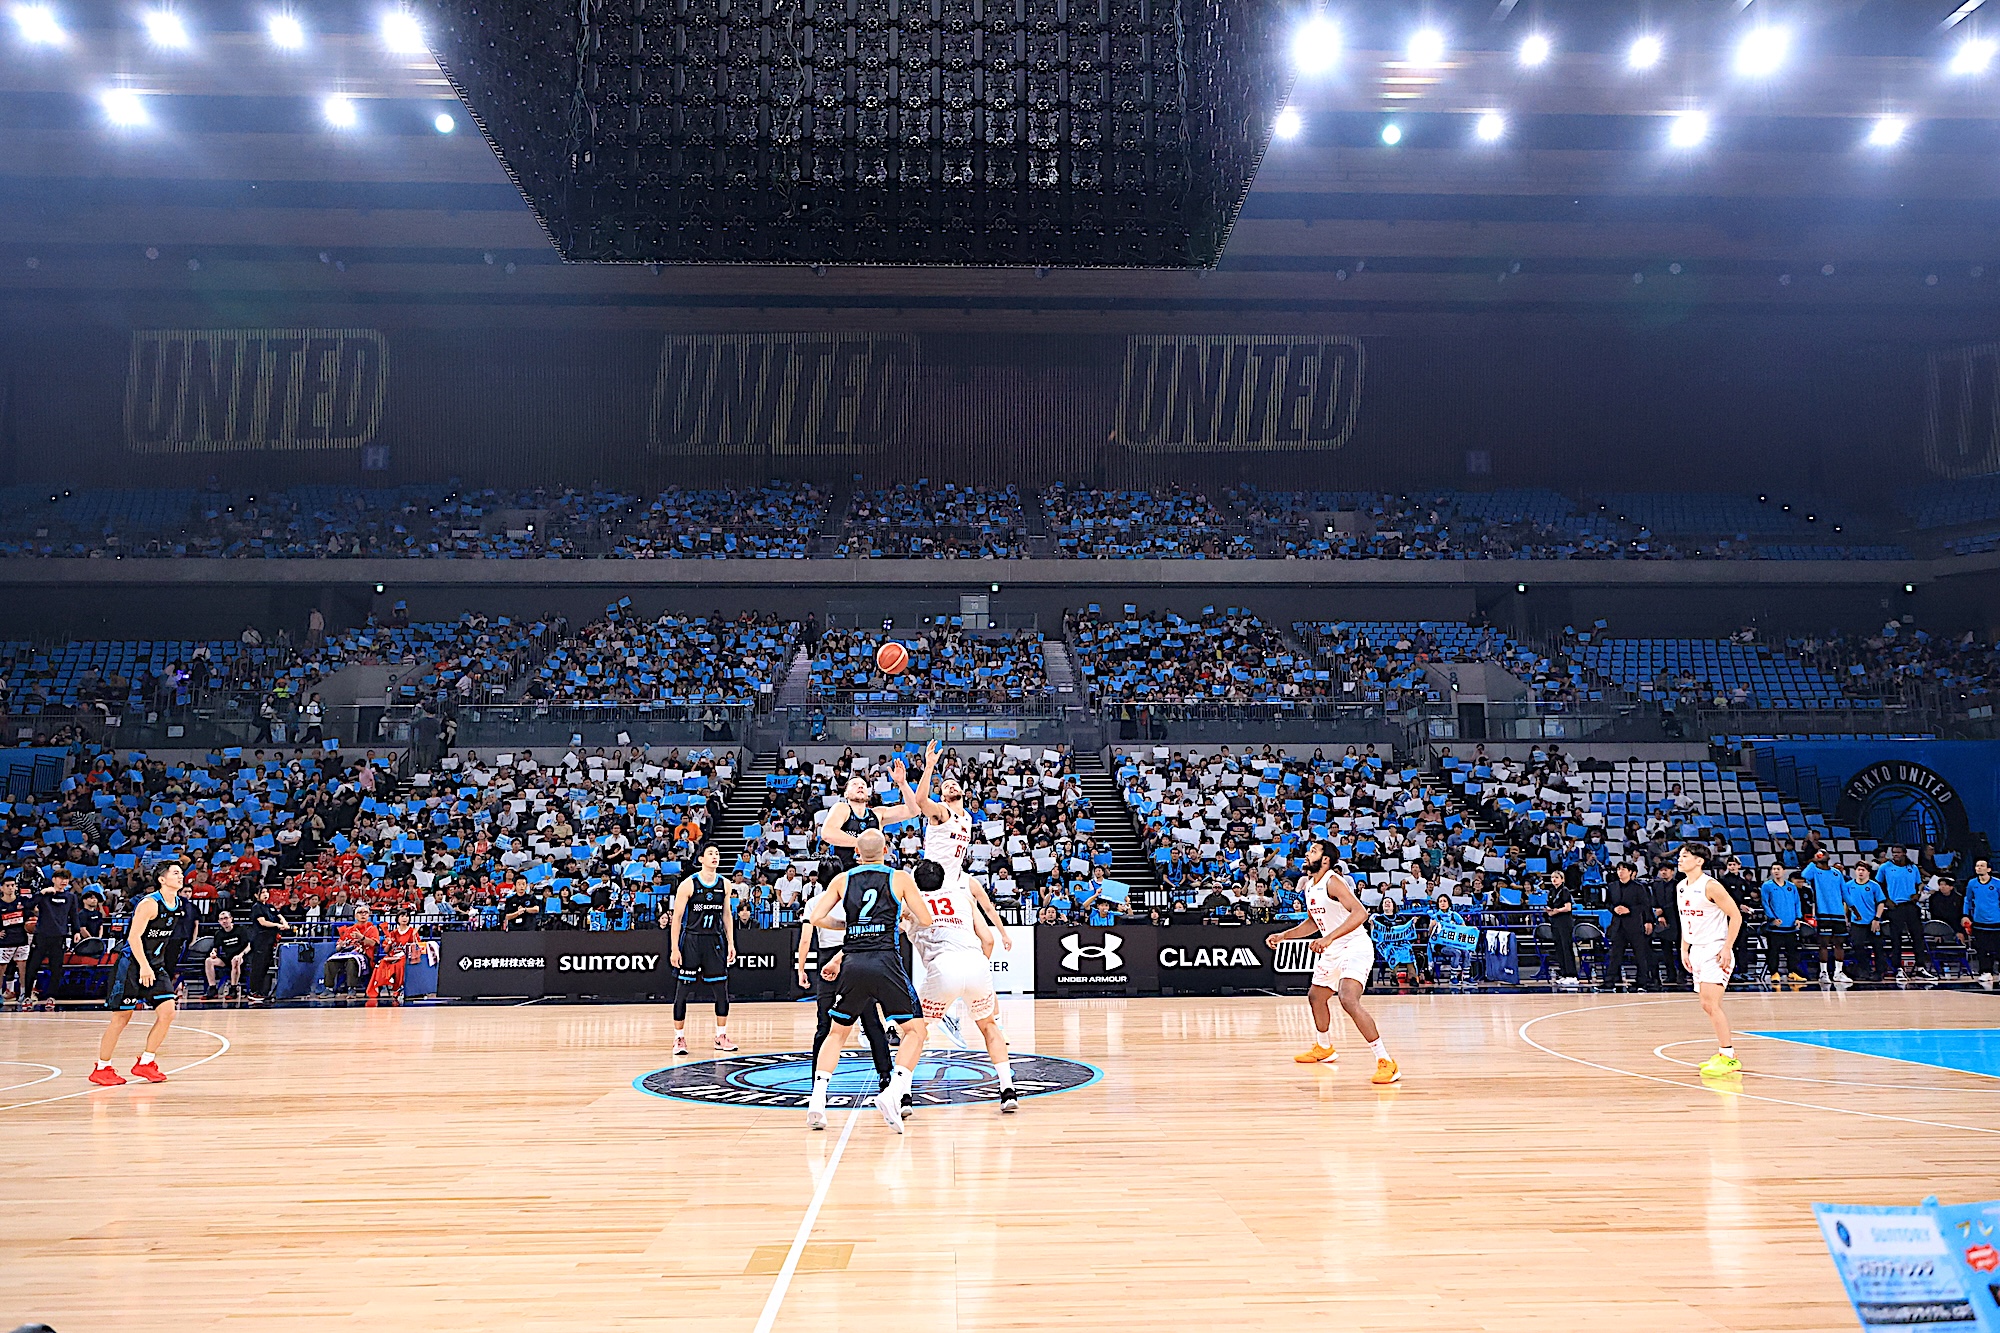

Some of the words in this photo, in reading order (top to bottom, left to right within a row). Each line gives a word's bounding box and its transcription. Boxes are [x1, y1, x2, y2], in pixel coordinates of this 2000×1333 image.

[127, 331, 387, 450] UNITED
[650, 334, 919, 452] UNITED
[1116, 337, 1365, 451] UNITED
[1846, 765, 1891, 801] TOKYO
[1899, 765, 1952, 803] UNITED
[857, 888, 878, 924] 2
[928, 897, 955, 916] 13
[703, 915, 714, 928] 11
[473, 957, 545, 969] 日本管財株式会社
[559, 955, 659, 971] SUNTORY
[727, 955, 775, 968] PTENI
[1057, 975, 1088, 983] UNDER
[1088, 975, 1127, 983] ARMOUR
